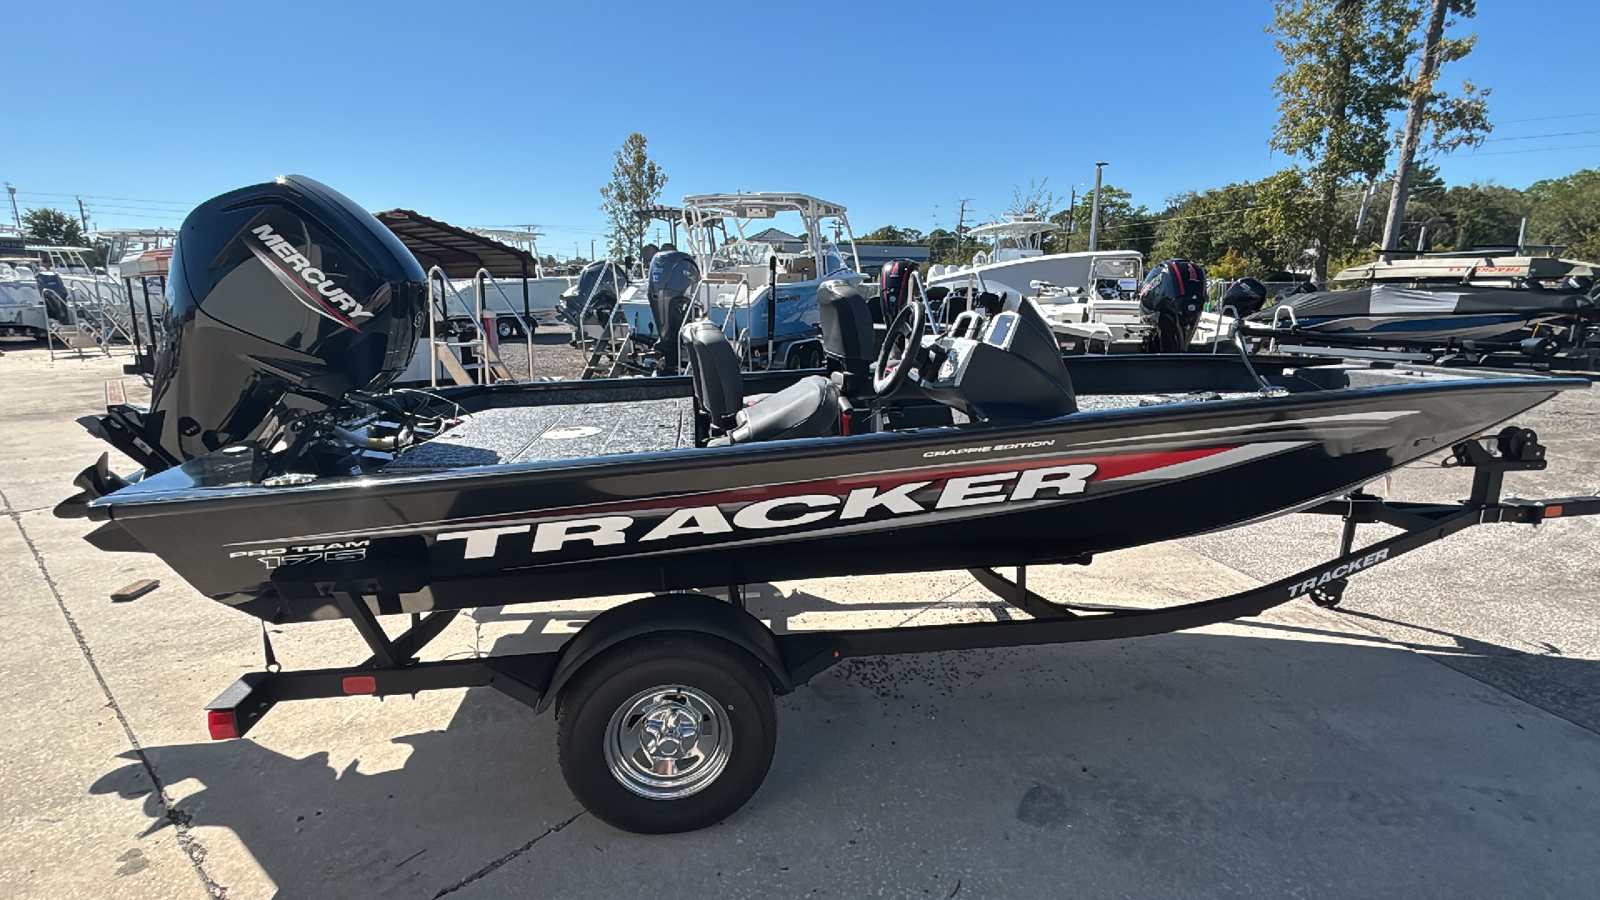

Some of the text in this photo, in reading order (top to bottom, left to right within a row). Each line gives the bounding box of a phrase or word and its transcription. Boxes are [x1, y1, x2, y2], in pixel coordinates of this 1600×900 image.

[252, 224, 374, 317] MERCURY
[923, 440, 1056, 458] CRAPPIE EDITION
[437, 463, 1098, 560] TRACKER
[229, 540, 371, 559] PRO TEAM
[1287, 548, 1389, 597] TRACKER
